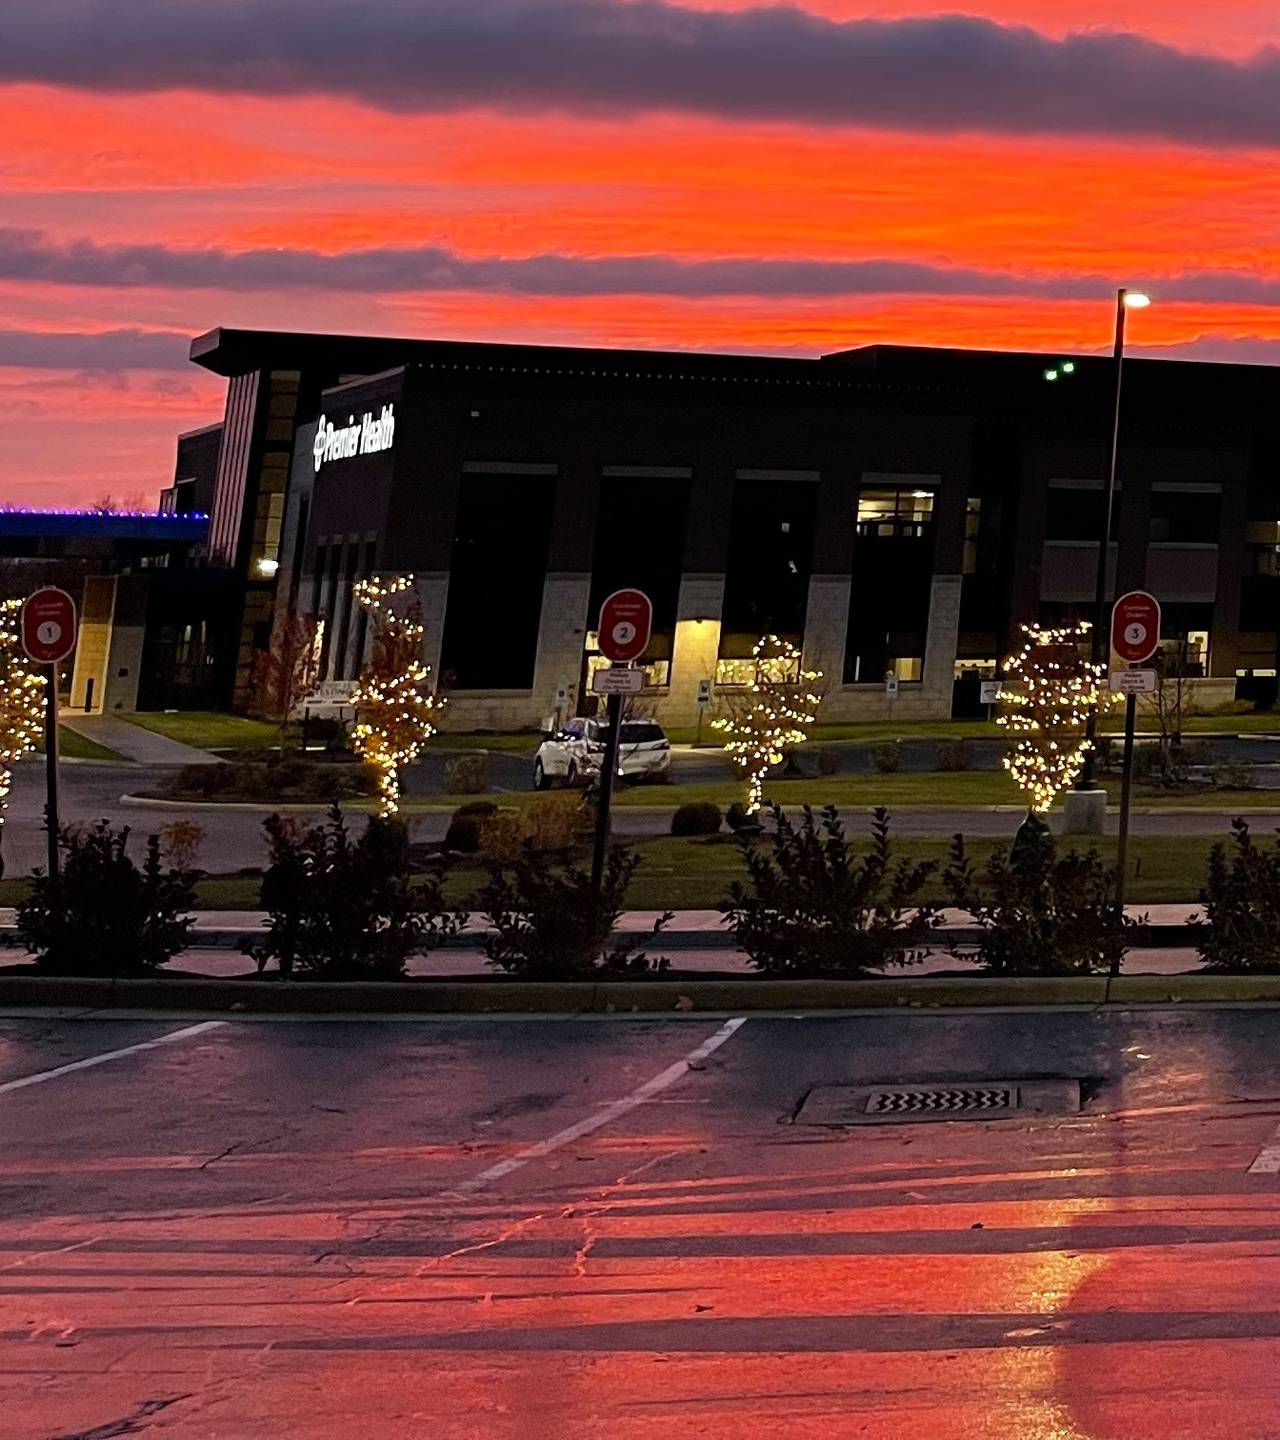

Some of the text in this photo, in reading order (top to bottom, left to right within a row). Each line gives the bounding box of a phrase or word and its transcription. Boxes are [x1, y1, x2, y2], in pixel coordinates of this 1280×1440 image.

[323, 403, 395, 462] Premier Health
[619, 626, 629, 639] 2
[1131, 628, 1140, 639] 3
